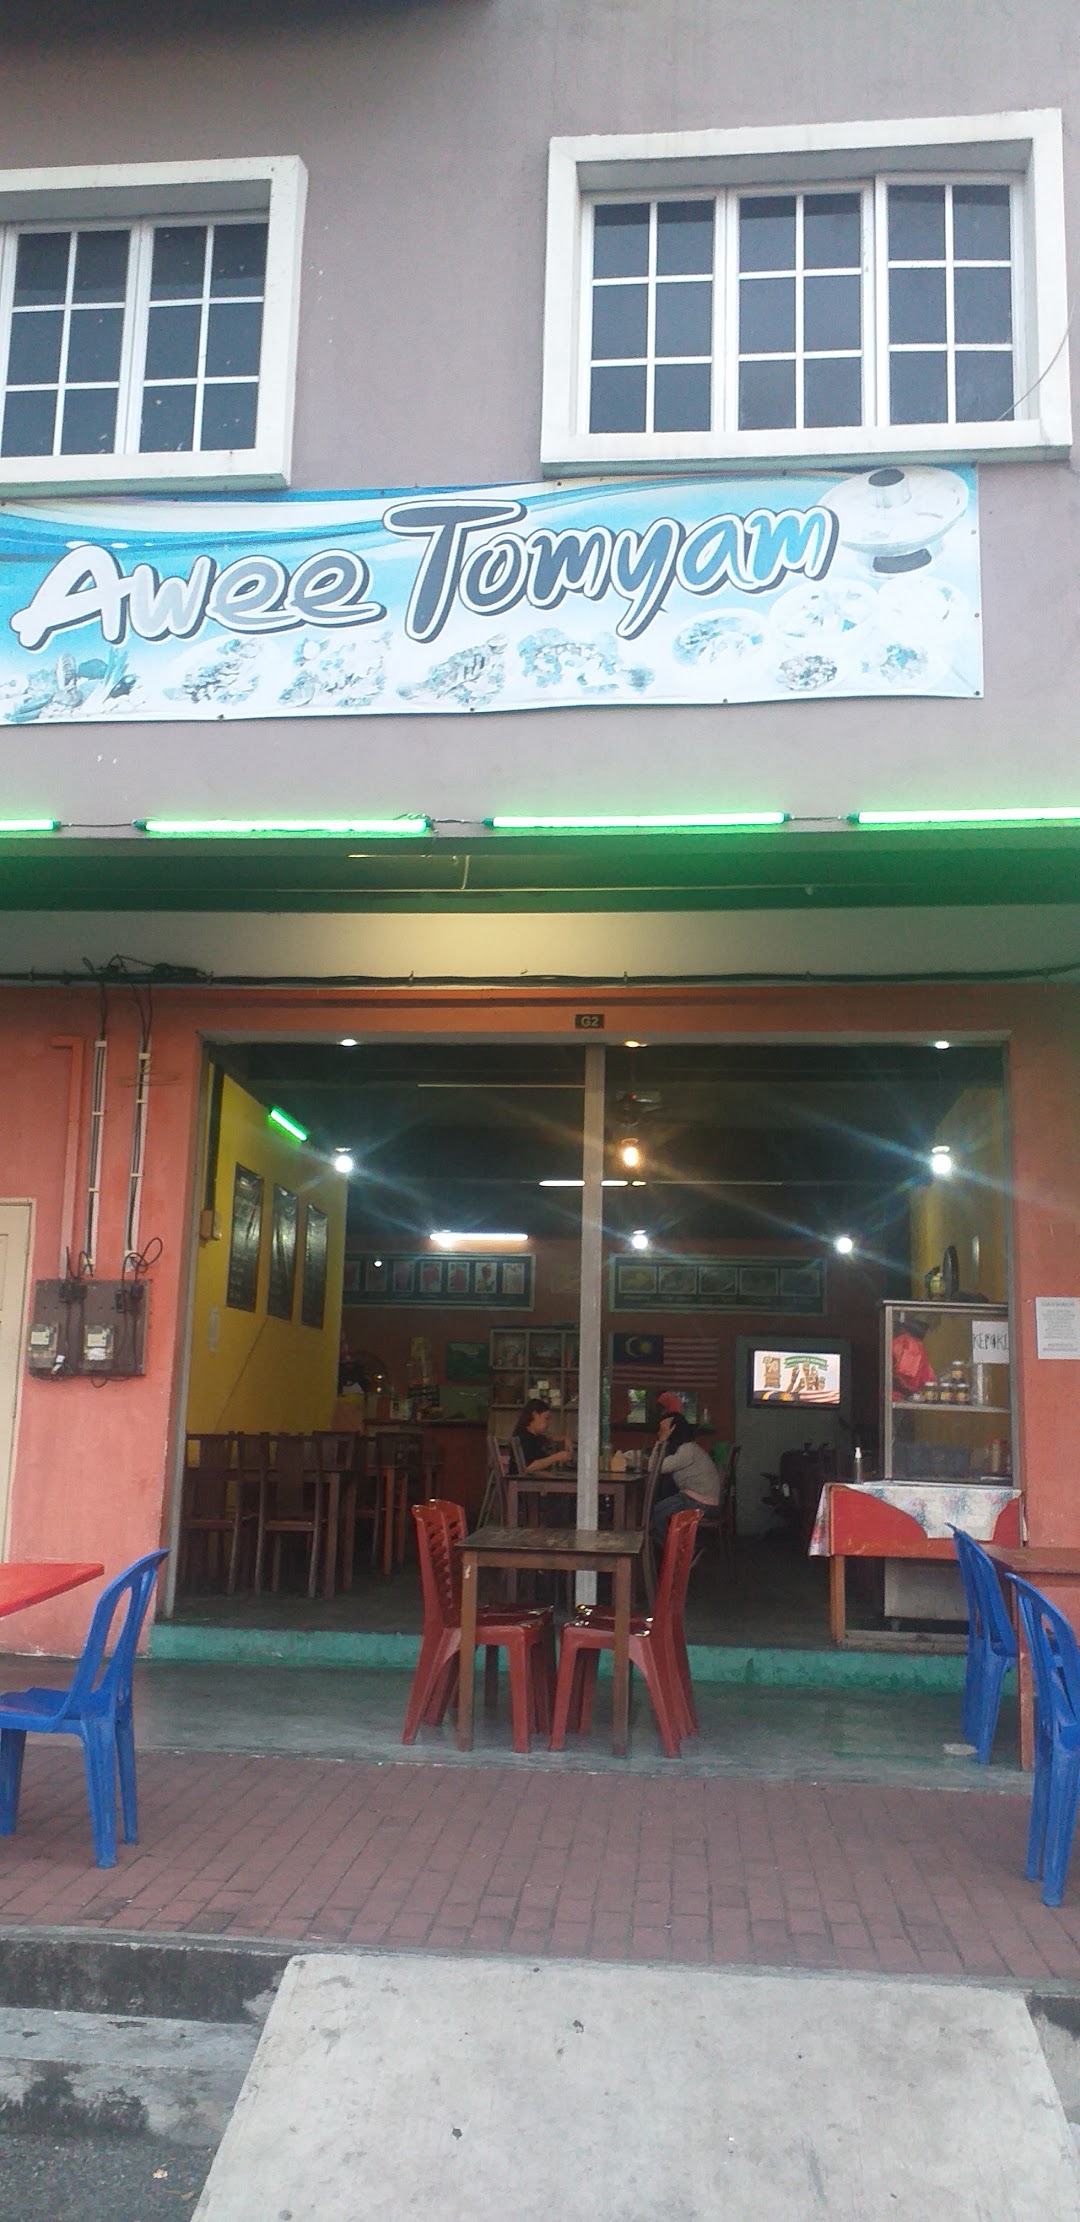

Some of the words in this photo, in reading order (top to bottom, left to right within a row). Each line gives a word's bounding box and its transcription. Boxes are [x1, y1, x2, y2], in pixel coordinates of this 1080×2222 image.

[11, 546, 382, 650] Awee
[384, 498, 839, 641] Tomyam
[580, 1016, 599, 1027] G2
